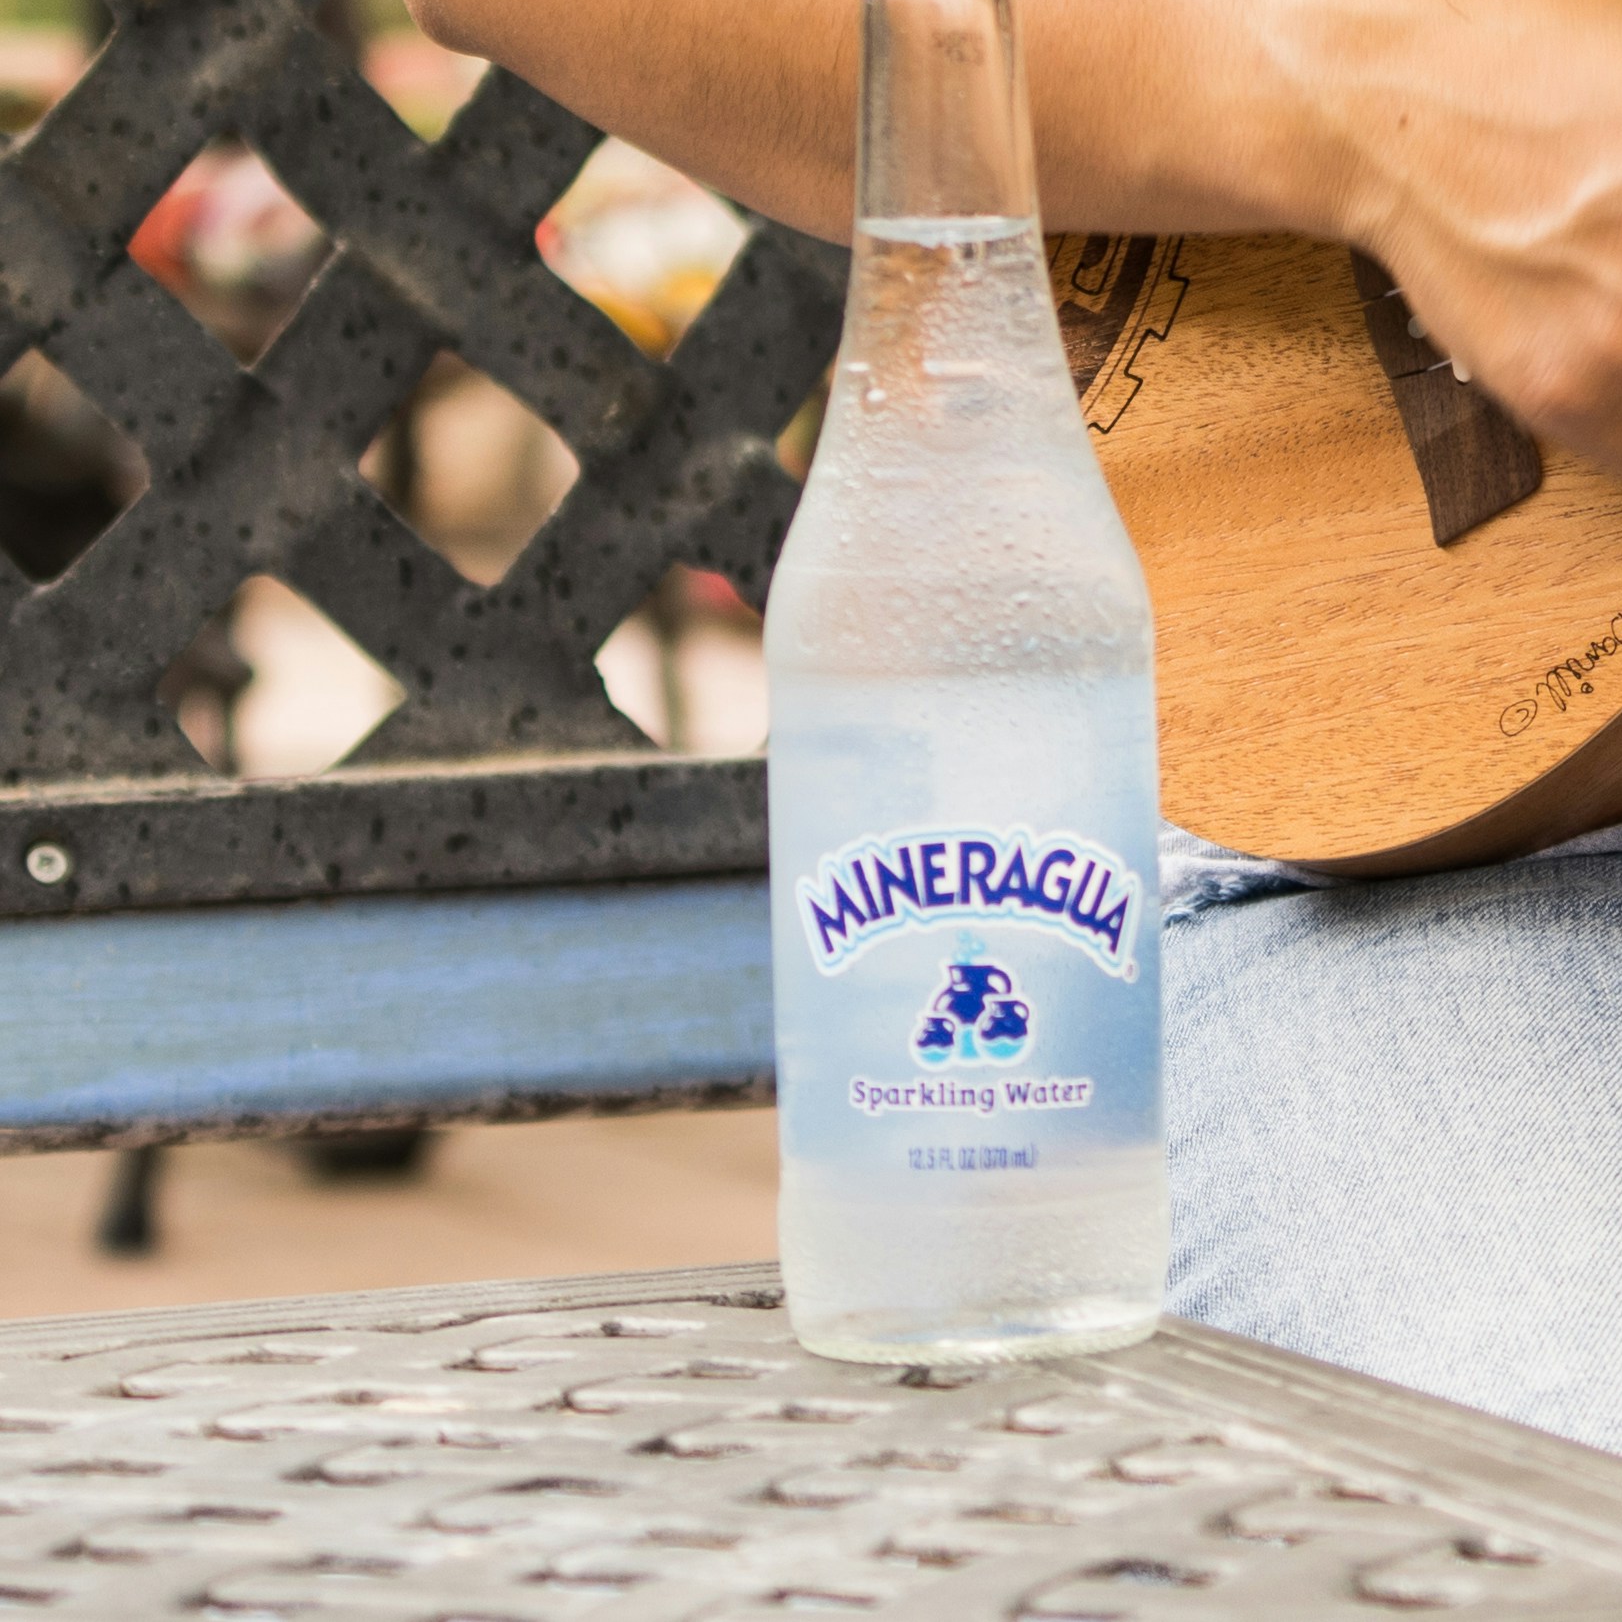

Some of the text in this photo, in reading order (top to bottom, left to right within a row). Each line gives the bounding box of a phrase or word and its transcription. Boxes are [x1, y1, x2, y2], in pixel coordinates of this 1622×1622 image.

[806, 841, 1131, 955] MINERAGUA
[852, 1080, 1089, 1112] Sparkling Water
